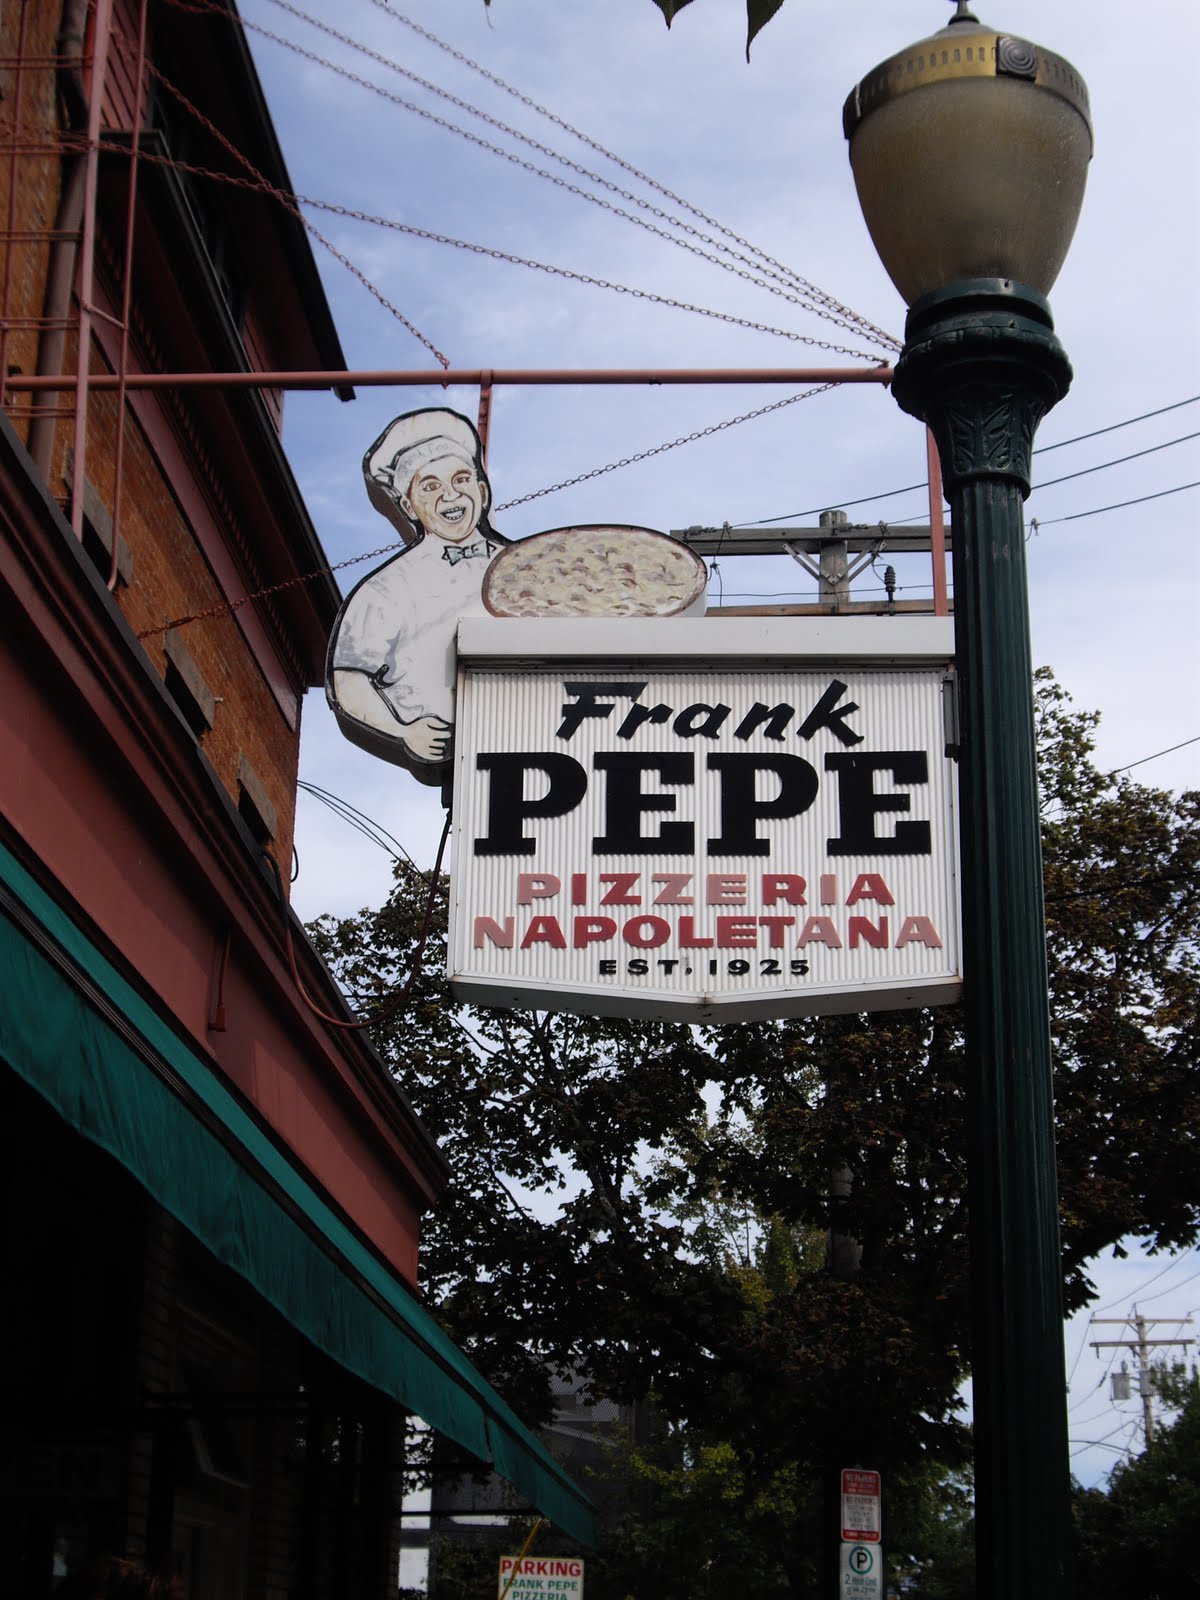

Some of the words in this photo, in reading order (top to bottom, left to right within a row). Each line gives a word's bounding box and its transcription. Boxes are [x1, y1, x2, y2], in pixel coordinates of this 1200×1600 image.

[556, 679, 865, 747] Frank
[474, 751, 932, 856] PEPE
[517, 873, 896, 906] PIZZERIA
[474, 915, 943, 950] NAPOLETANA
[599, 959, 693, 976] EST.
[709, 959, 810, 976] 1925
[501, 1560, 581, 1577] PARKING
[856, 1551, 868, 1569] P
[547, 1580, 578, 1591] PEPE
[512, 1591, 568, 1600] PIZZERIA
